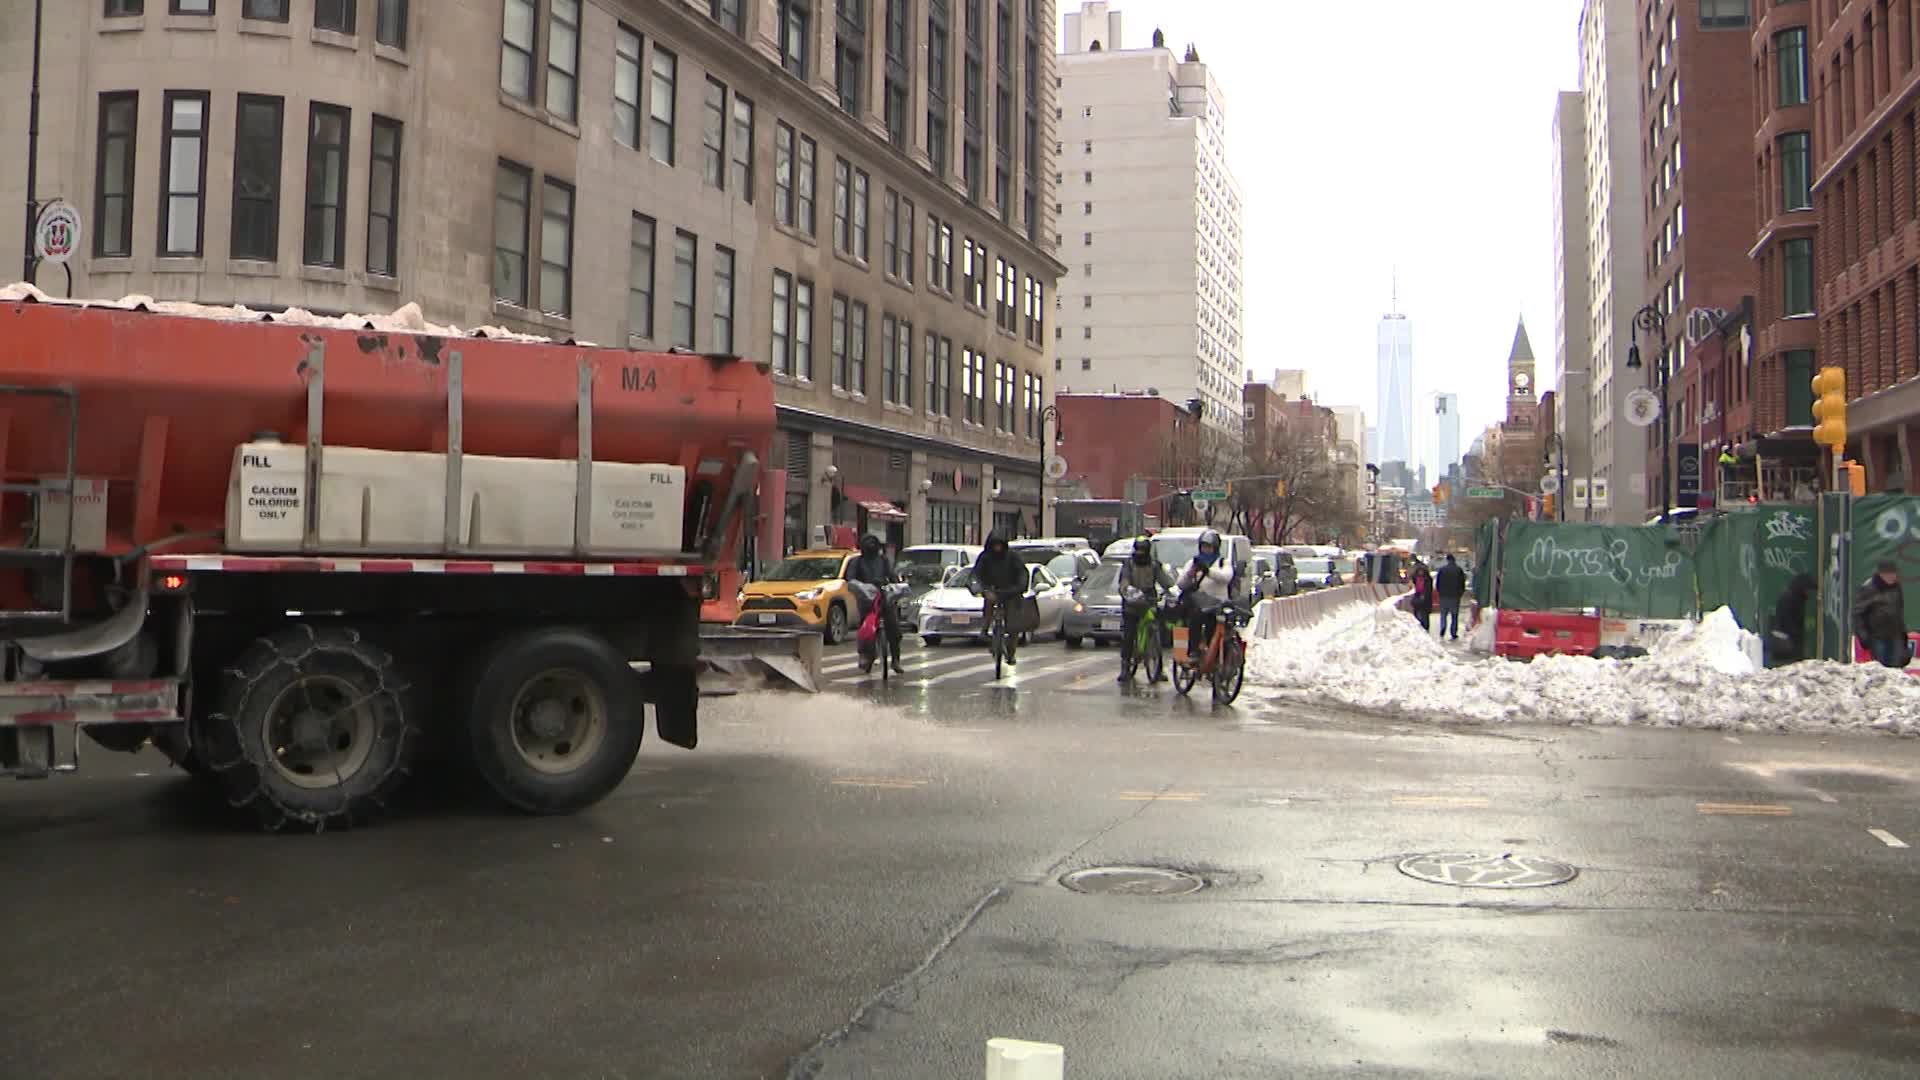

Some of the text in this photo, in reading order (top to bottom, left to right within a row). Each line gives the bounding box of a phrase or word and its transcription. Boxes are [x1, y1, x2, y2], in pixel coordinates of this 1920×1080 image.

[243, 456, 271, 468] FILL
[650, 473, 672, 484] FILL
[252, 486, 297, 496] CALCIUM
[248, 498, 299, 508] CHLORIDE
[259, 511, 286, 519] ONLY
